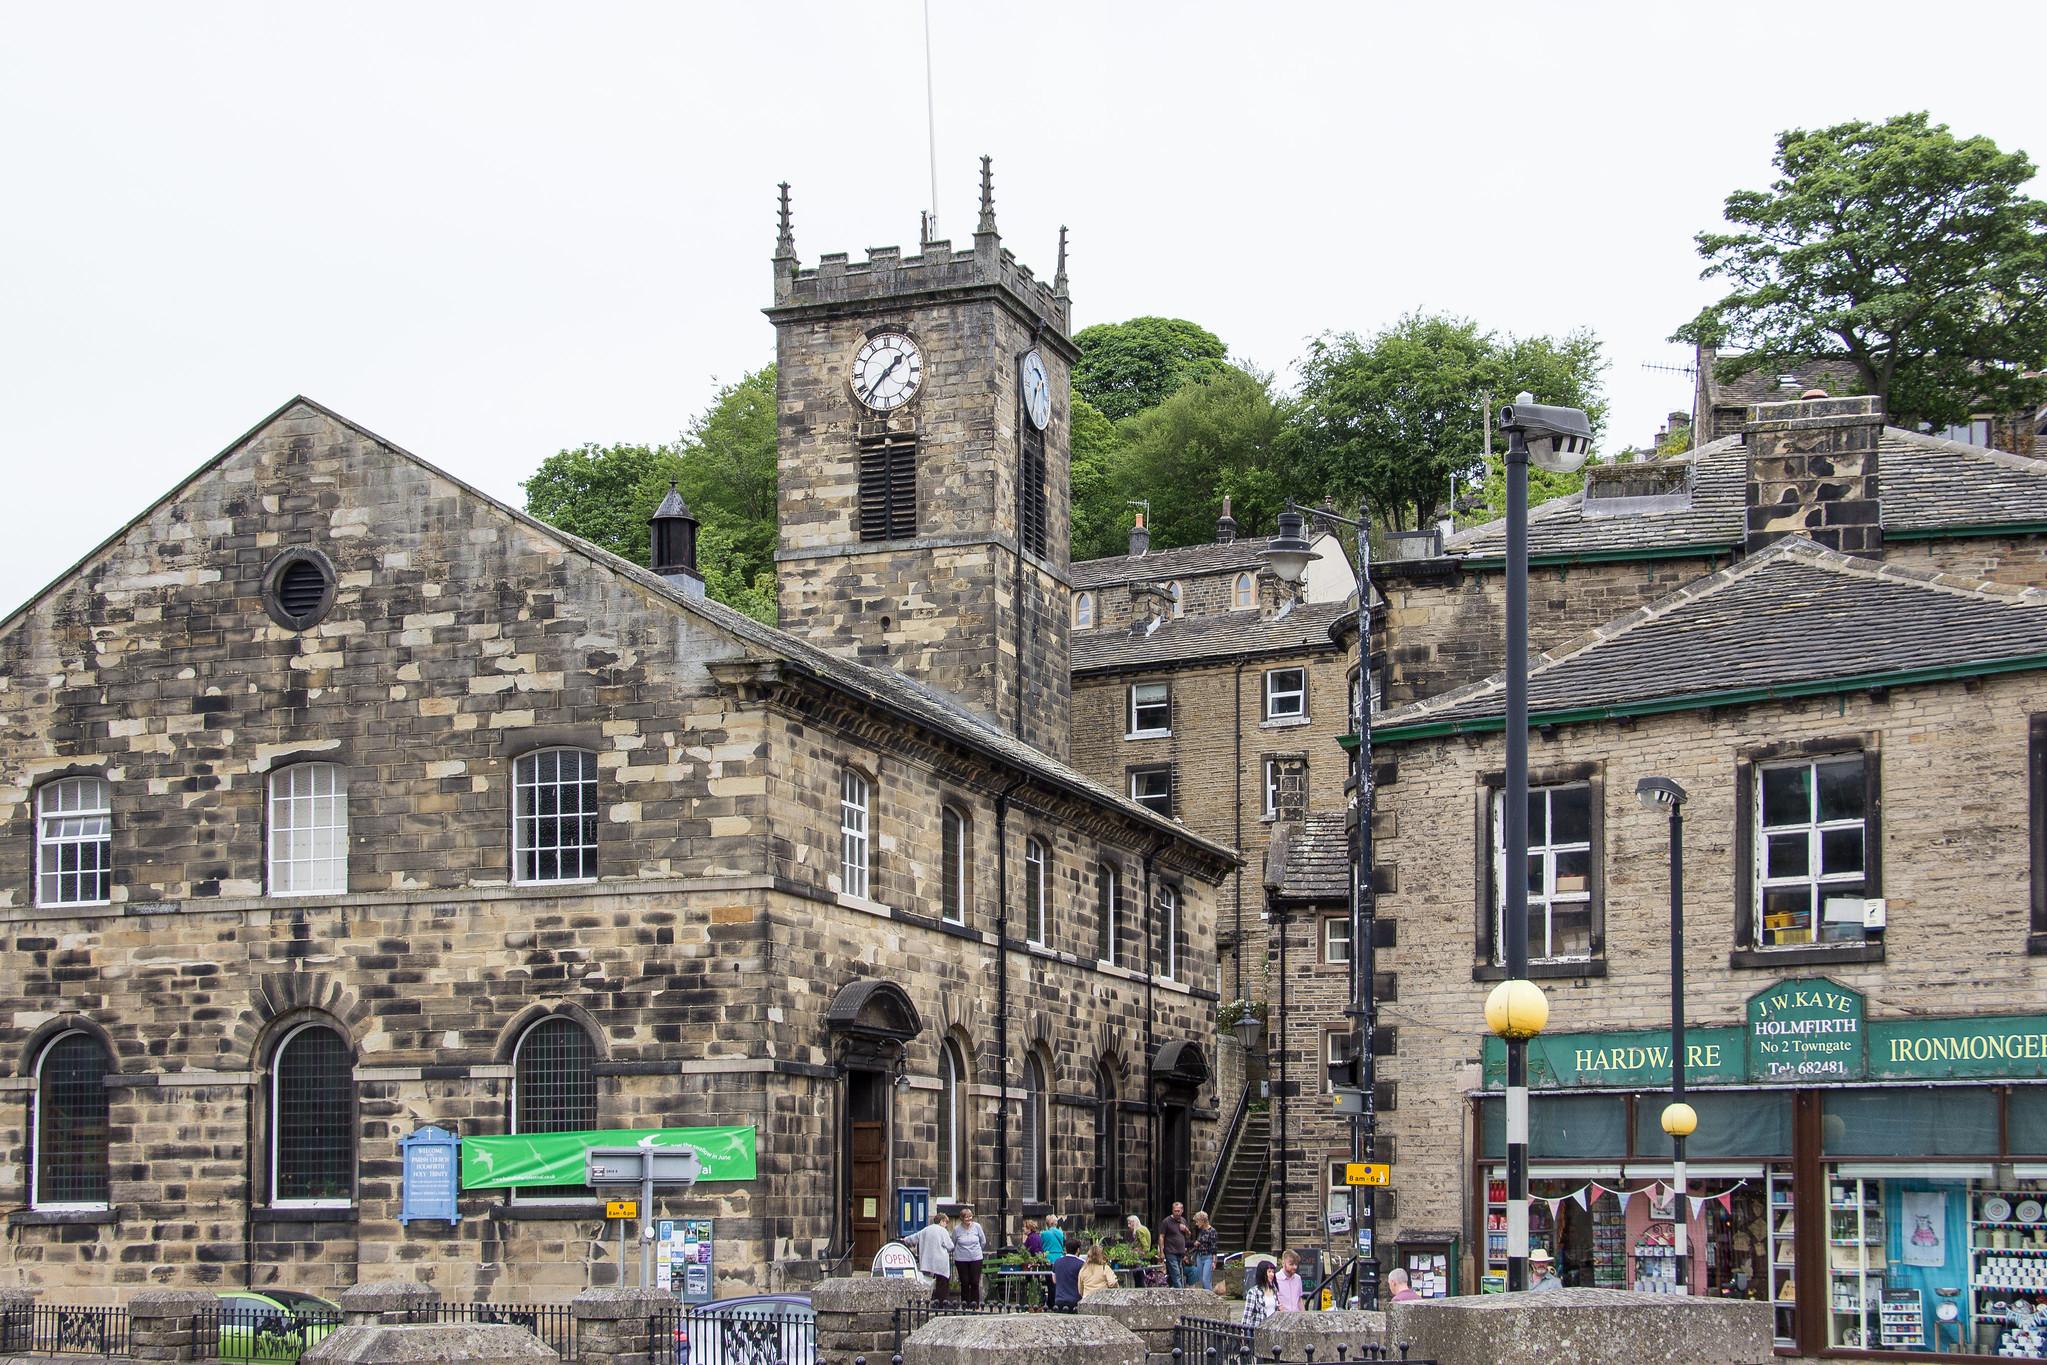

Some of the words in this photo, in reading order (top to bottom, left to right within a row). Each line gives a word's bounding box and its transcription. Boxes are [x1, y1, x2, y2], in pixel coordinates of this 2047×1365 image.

[1754, 1018, 1857, 1036] HOLMFIRTH
[1760, 1041, 1779, 1053] No
[1781, 1040, 1789, 1052] 2
[1792, 1040, 1852, 1054] Towngate
[1575, 1044, 1722, 1071] HARDWRE
[1798, 1060, 1844, 1075] 682481
[884, 1253, 911, 1265] OPEN
